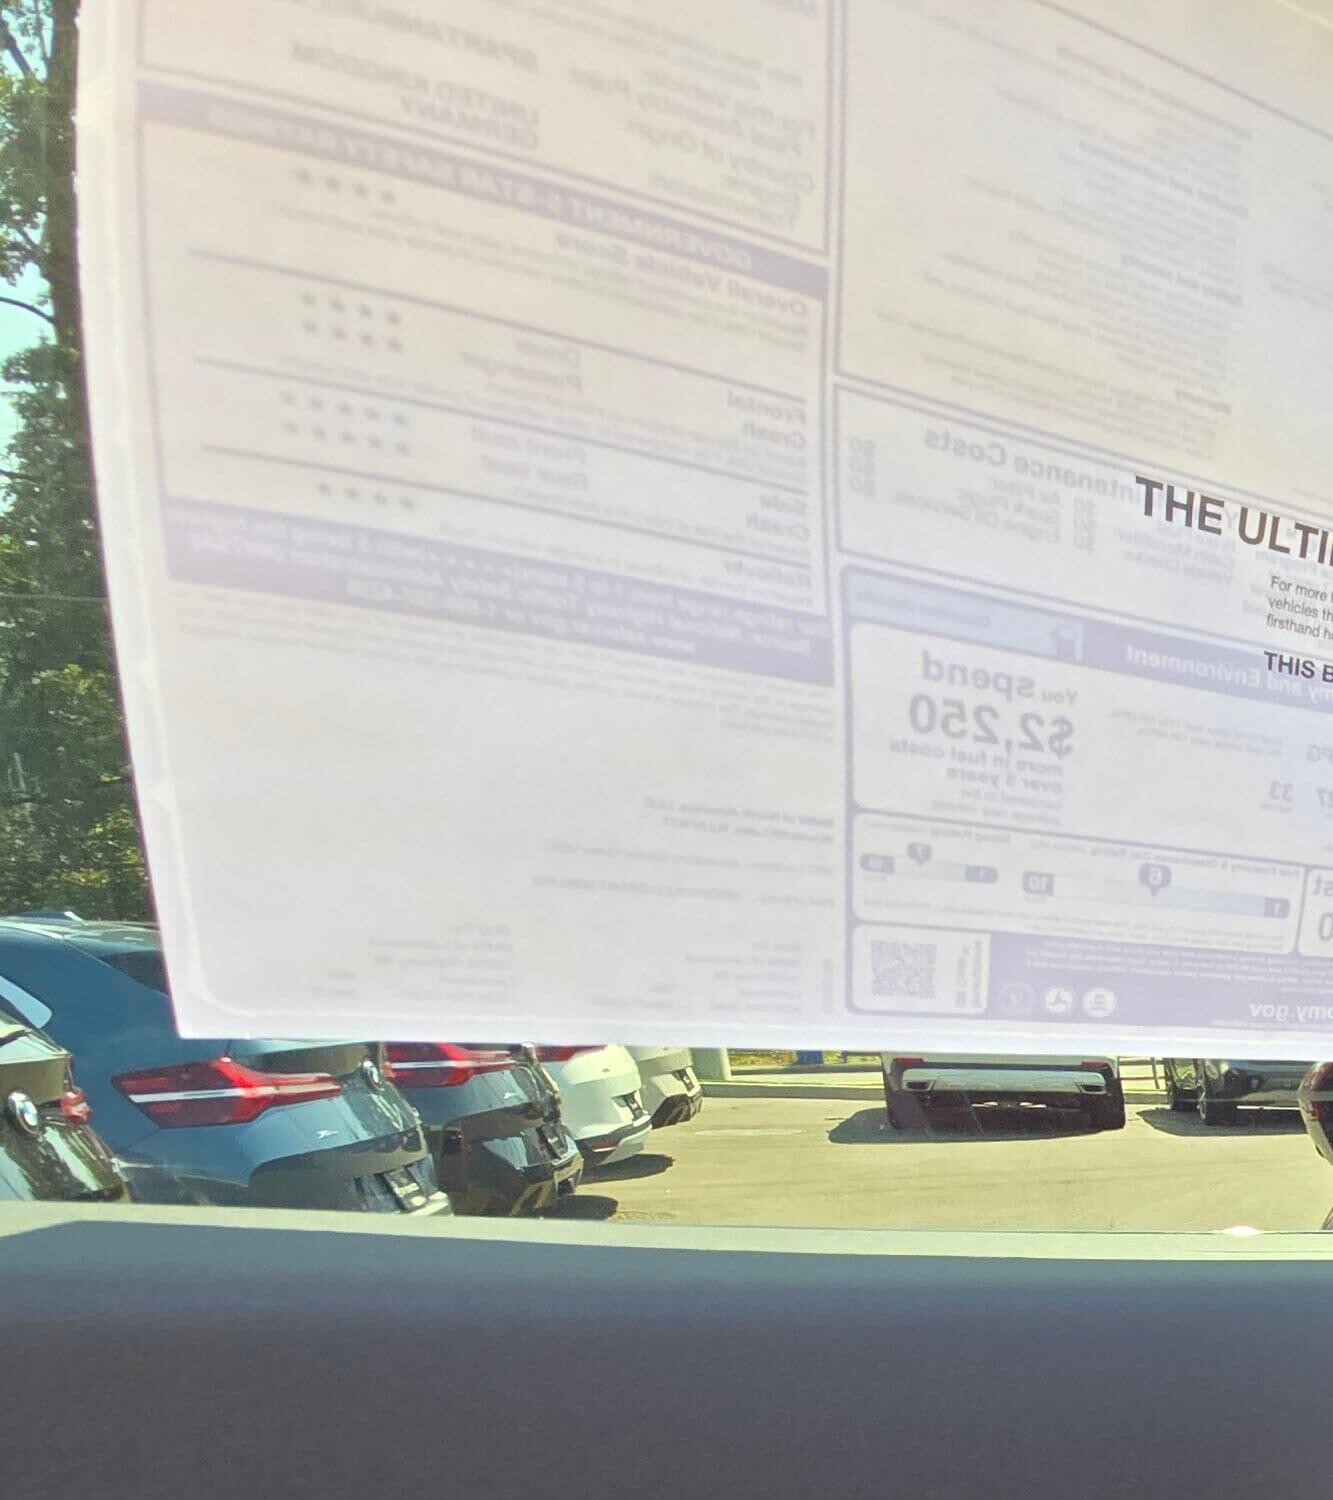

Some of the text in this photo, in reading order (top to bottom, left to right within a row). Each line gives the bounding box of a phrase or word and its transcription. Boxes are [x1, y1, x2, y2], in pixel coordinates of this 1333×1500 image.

[1135, 475, 1225, 535] THE
[1270, 575, 1293, 592] For
[1295, 584, 1328, 601] more
[1268, 597, 1318, 618] vehicles
[1266, 613, 1320, 638] firsthand
[1264, 650, 1316, 679] THIS
